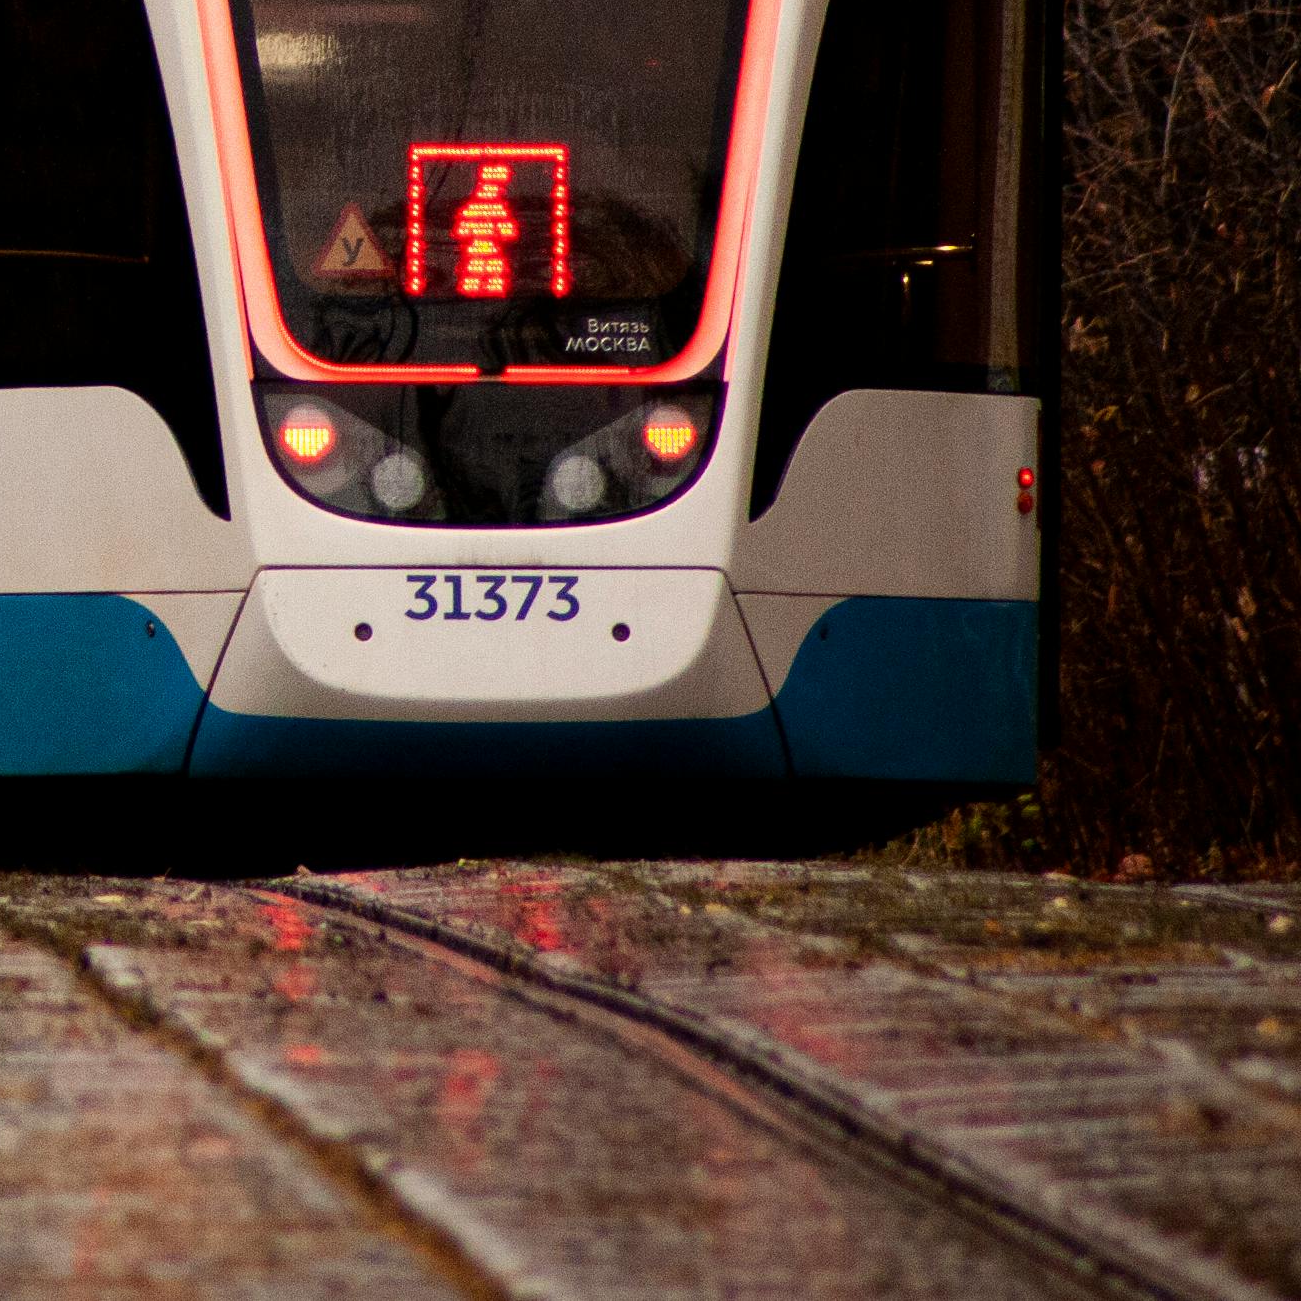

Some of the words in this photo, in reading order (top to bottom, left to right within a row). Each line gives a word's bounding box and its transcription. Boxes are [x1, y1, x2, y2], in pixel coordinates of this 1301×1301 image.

[587, 318, 650, 334] Витязь
[564, 336, 652, 352] МОСКВА
[404, 574, 581, 622] 31373
